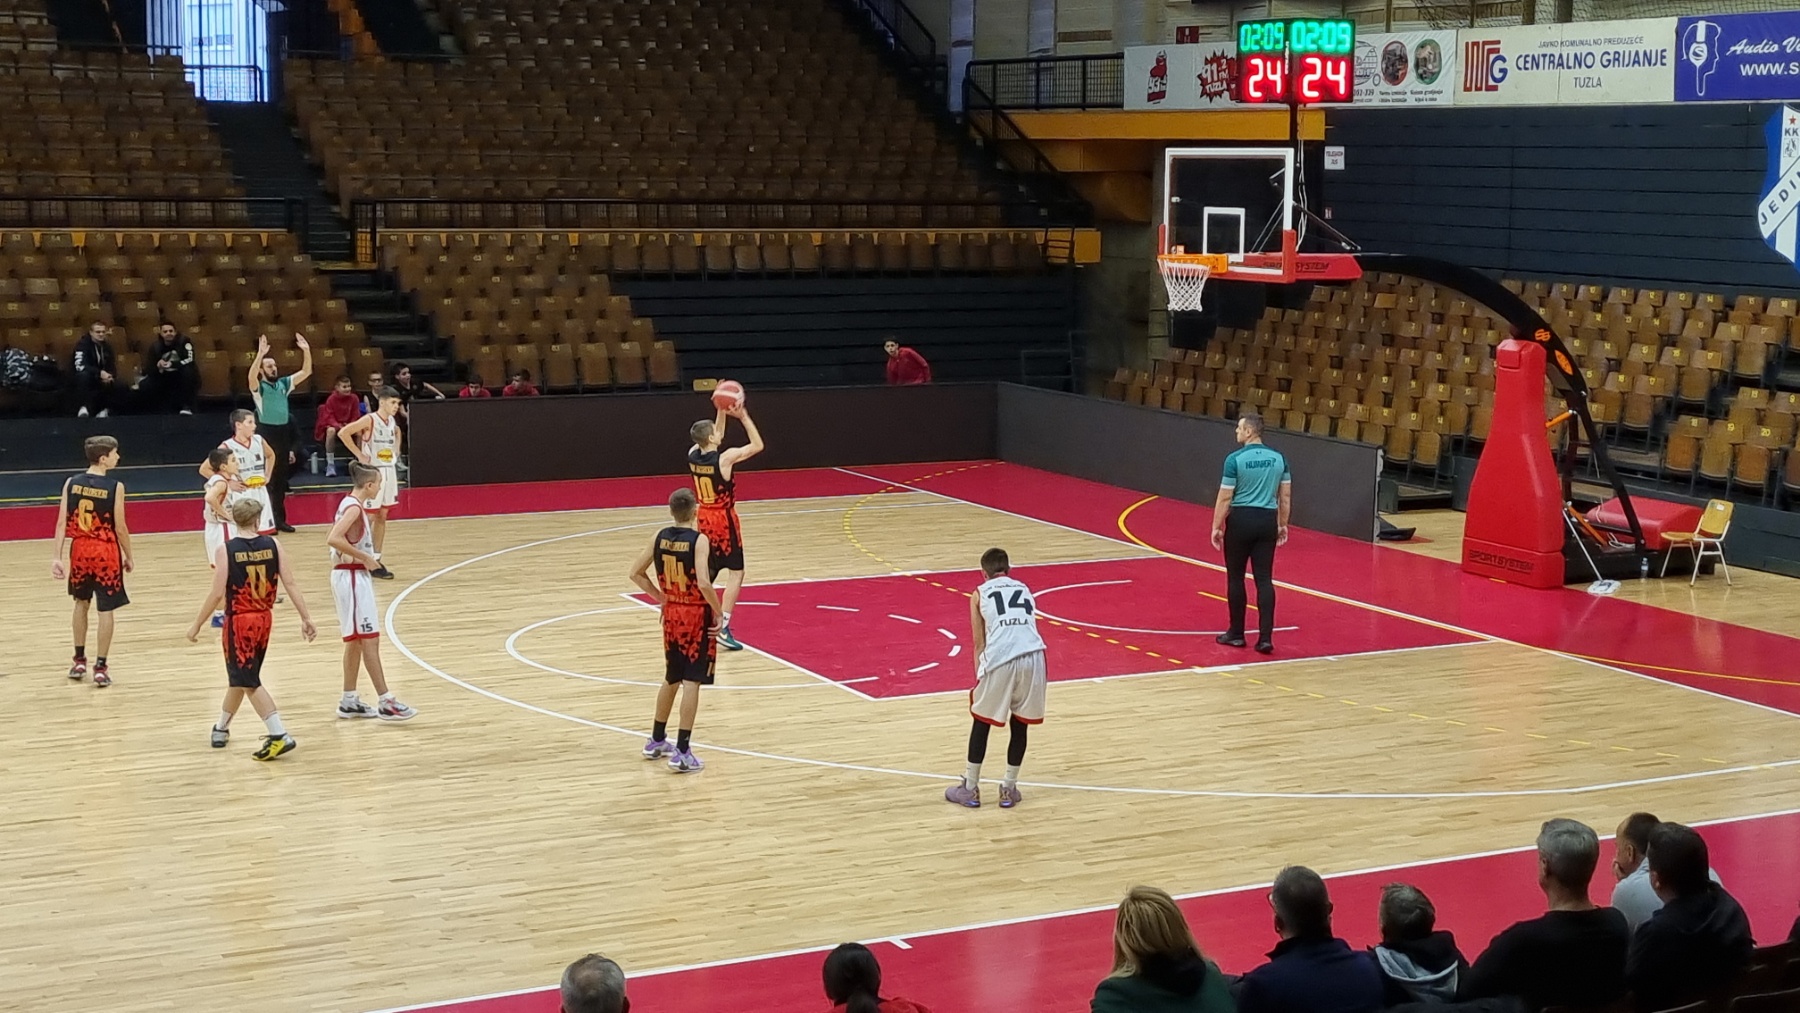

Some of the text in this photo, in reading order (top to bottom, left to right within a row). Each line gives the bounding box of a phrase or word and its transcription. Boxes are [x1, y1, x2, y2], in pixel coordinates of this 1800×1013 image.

[1240, 22, 1284, 51] 02:09
[1291, 21, 1351, 53] 02:09
[1538, 40, 1559, 48] JAVNO
[1560, 38, 1602, 47] KOMUNALNO
[1726, 36, 1800, 56] Audio V
[1515, 48, 1667, 71] CENTRALNO GRIJANJE
[1248, 58, 1282, 98] 24
[1302, 57, 1347, 98] 24
[1574, 76, 1602, 88] TUZLA
[1784, 128, 1799, 136] KK
[1760, 170, 1800, 226] JEDI
[693, 475, 715, 504] 10
[78, 498, 94, 532] 6
[246, 564, 266, 600] 11
[662, 554, 687, 592] 14
[988, 589, 1034, 616] 14
[360, 622, 373, 632] 15
[1000, 618, 1028, 628] TUZLA
